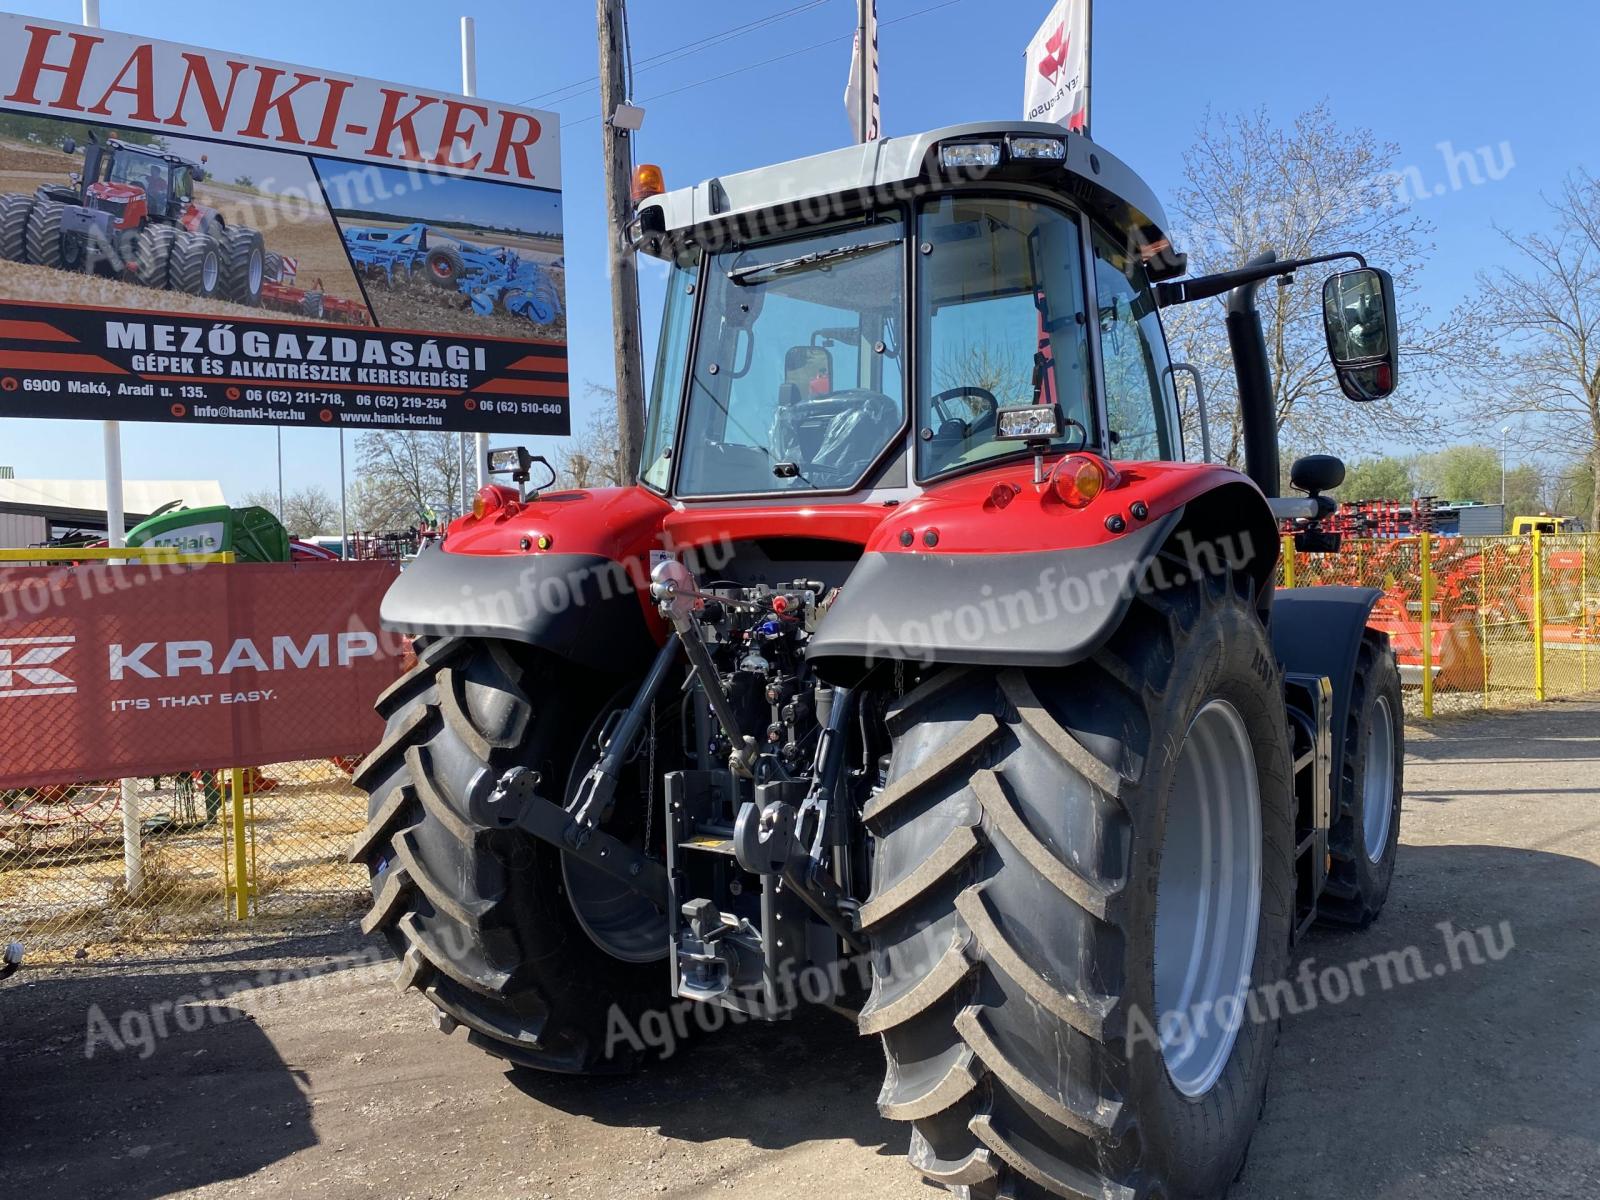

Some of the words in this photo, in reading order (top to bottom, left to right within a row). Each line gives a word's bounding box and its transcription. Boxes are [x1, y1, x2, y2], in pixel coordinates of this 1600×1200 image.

[4, 25, 542, 180] HANKI-KER
[106, 321, 486, 371] MEZŐGAZDASÁGI
[131, 353, 195, 374] GÉPEK
[201, 356, 224, 376] ÉS
[230, 360, 351, 382] ALKATRÉSZEK
[357, 367, 468, 388] KERESKEDÉSE
[23, 378, 60, 392] 6900
[67, 380, 111, 396] Makó,
[118, 382, 153, 397] Aradi
[161, 388, 173, 398] u.
[180, 386, 208, 398] 135.
[245, 389, 262, 401] 06
[266, 390, 292, 405] (62)
[296, 392, 345, 407] 211-718,
[356, 394, 371, 406] 06
[374, 395, 399, 409] (62)
[402, 396, 447, 409] 219-254
[480, 400, 494, 411] 06
[496, 401, 518, 414] (62)
[521, 402, 562, 414] 510-640
[194, 405, 305, 420] info@hanki-ker.hu
[340, 412, 442, 425] www.hanki-ker.hu
[109, 631, 377, 681] KRAMP
[111, 698, 150, 711] IT'S
[158, 694, 213, 708] THAT
[220, 689, 277, 704] EASY.
